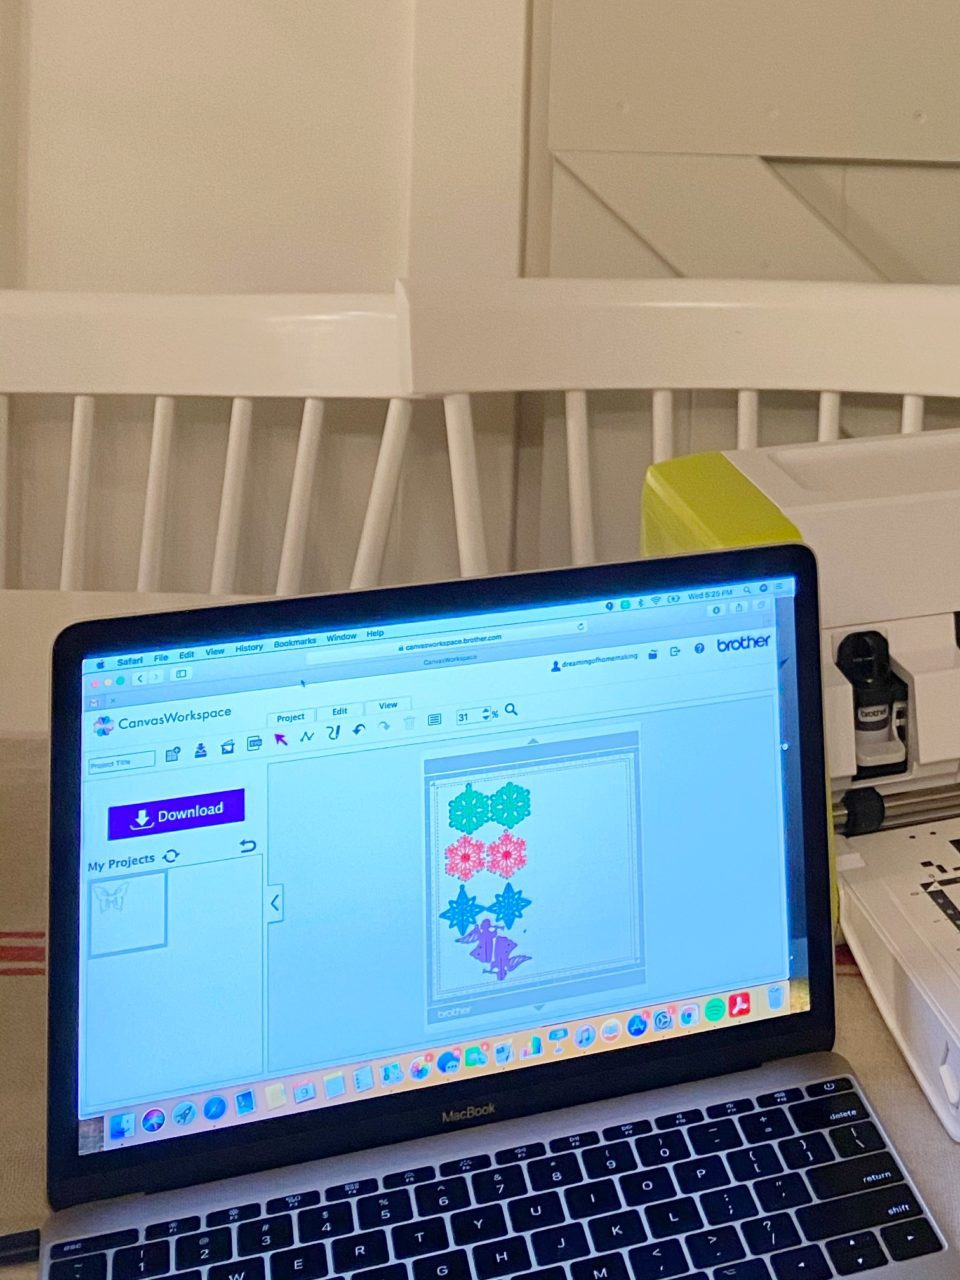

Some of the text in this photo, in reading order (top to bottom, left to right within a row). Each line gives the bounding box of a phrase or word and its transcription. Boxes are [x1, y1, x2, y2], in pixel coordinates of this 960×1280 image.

[116, 628, 384, 667] Safari File Edit View History Bookmarks Window Help
[405, 634, 502, 652] canvasworkspace.brother.com
[716, 634, 771, 653] brother
[561, 652, 638, 668] dreamingofhomemaking
[332, 706, 348, 716] Edit
[378, 700, 398, 711] View
[118, 706, 232, 731] CanvasWorkspace
[276, 712, 305, 724] Project
[458, 713, 469, 722] 31
[158, 801, 224, 822] Download
[88, 853, 156, 873] My Projects
[437, 1006, 472, 1018] brother
[441, 1102, 496, 1123] MacBook
[829, 1108, 858, 1121] delete
[606, 1159, 616, 1170] 9
[552, 1171, 562, 1182] 8
[696, 1169, 706, 1179] P
[862, 1171, 892, 1184] return
[495, 1184, 506, 1195] 7
[641, 1180, 653, 1191] O
[438, 1196, 449, 1207] 6
[381, 1209, 391, 1220] 5
[530, 1205, 542, 1216] U
[887, 1203, 910, 1216] shift
[668, 1212, 680, 1223] L
[321, 1222, 332, 1233] 4
[473, 1218, 484, 1230] Y
[611, 1225, 623, 1236] K
[261, 1236, 272, 1246] 3
[414, 1231, 425, 1243] T
[557, 1237, 566, 1249] J
[200, 1249, 210, 1260] 2
[354, 1245, 366, 1257] R
[495, 1251, 508, 1263] H
[294, 1258, 304, 1270] E
[436, 1264, 449, 1276] G
[593, 1267, 608, 1280] M
